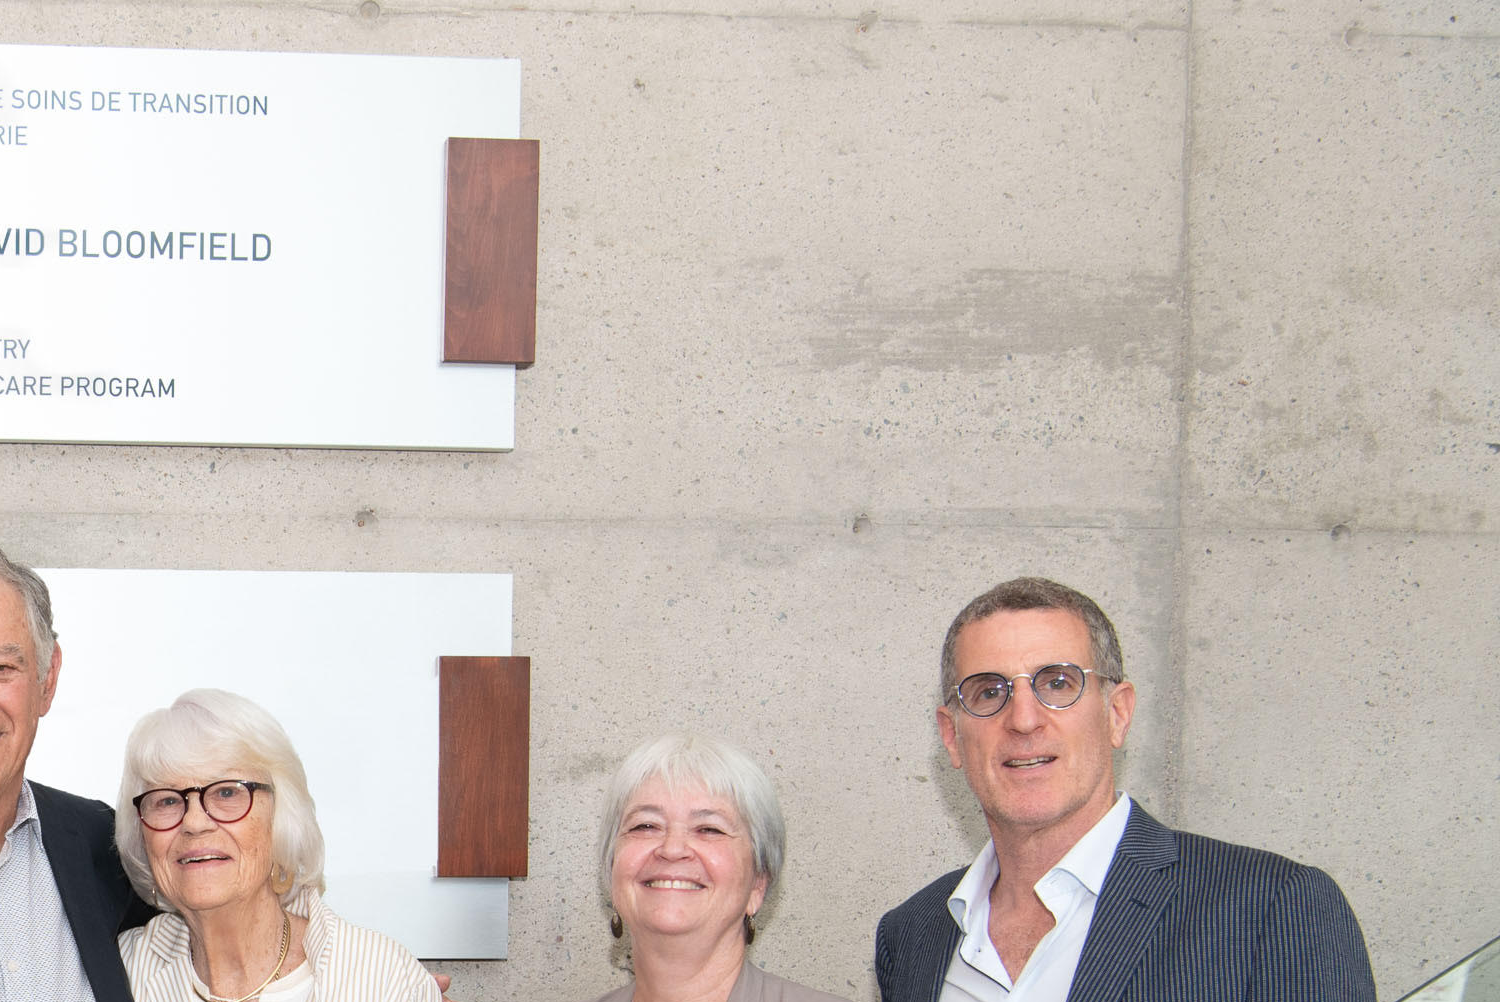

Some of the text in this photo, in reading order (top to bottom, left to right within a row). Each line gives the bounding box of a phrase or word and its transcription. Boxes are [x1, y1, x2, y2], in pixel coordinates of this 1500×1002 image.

[11, 88, 83, 111] SOINS
[90, 91, 122, 113] DE
[127, 91, 269, 117] TRANSITION
[58, 228, 272, 263] BLOOMFIELD
[60, 375, 176, 399] PROGRAM
